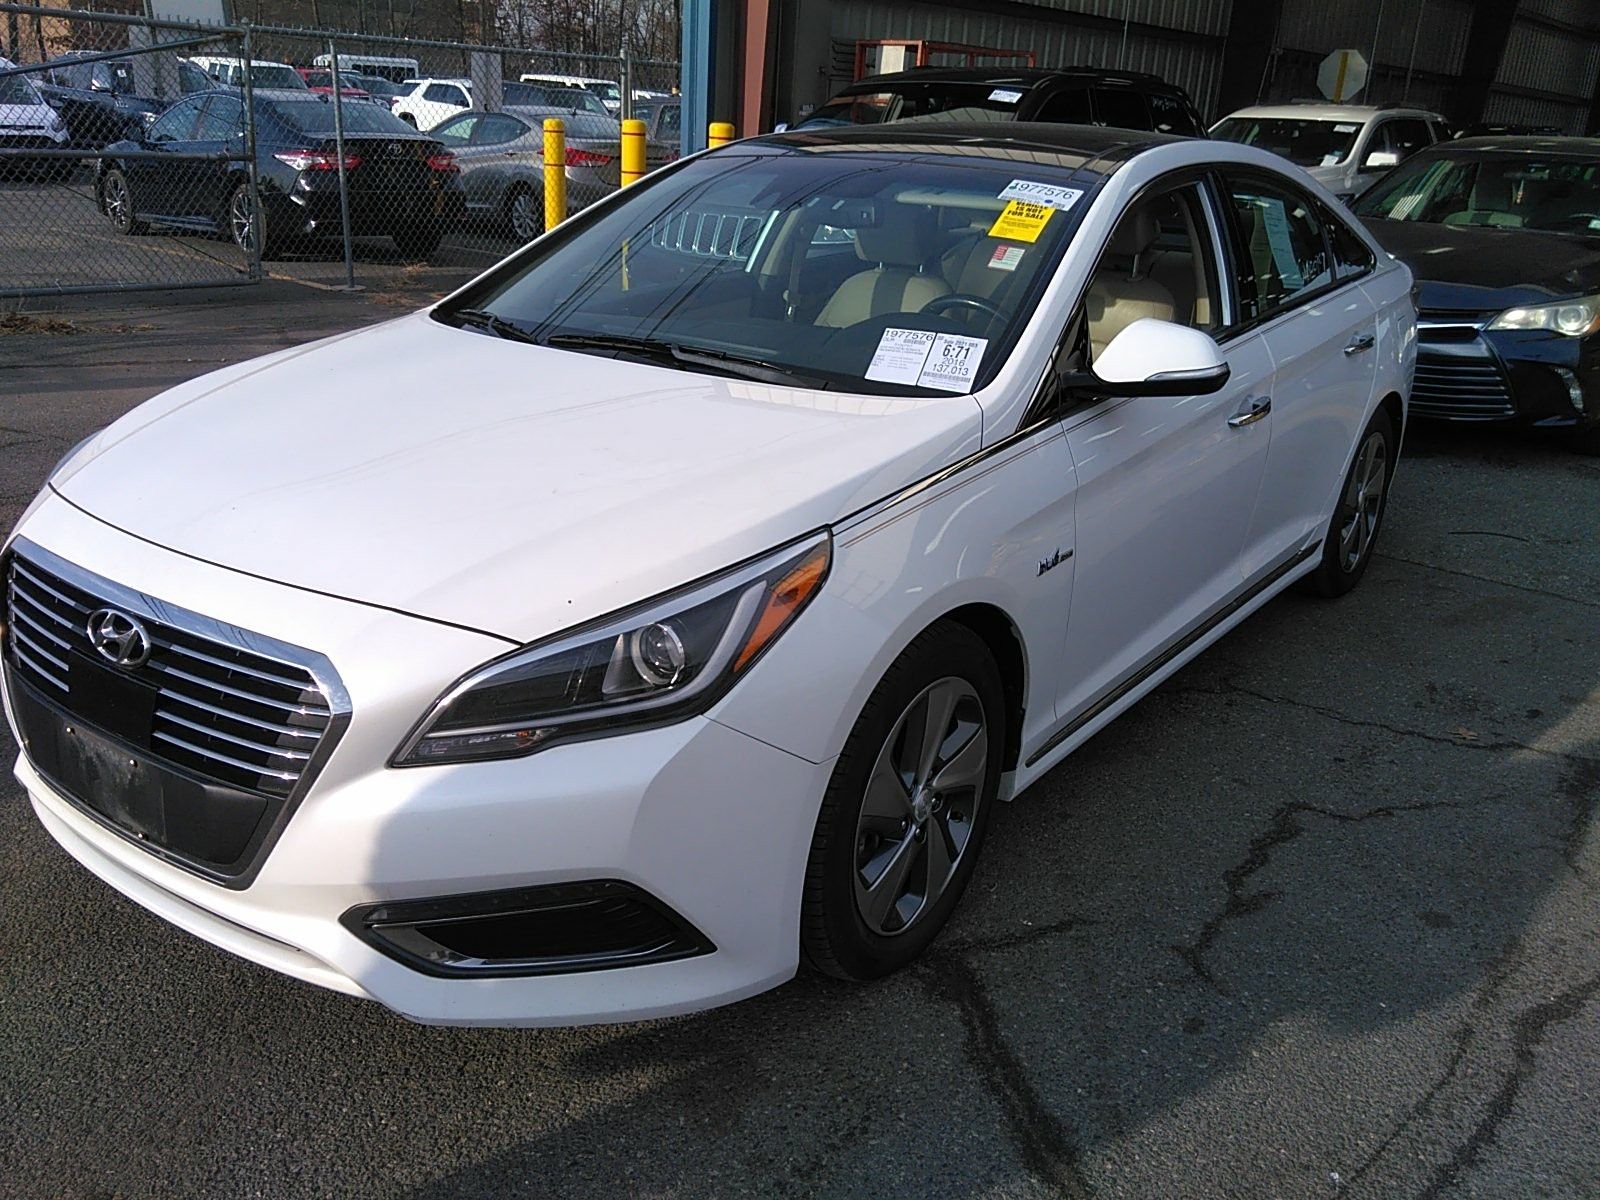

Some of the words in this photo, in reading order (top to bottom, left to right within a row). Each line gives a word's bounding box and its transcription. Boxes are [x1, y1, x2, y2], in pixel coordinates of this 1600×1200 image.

[1013, 182, 1075, 199] 1977576
[885, 330, 935, 341] 1977576
[942, 344, 971, 359] 6:71
[941, 357, 966, 367] 2016
